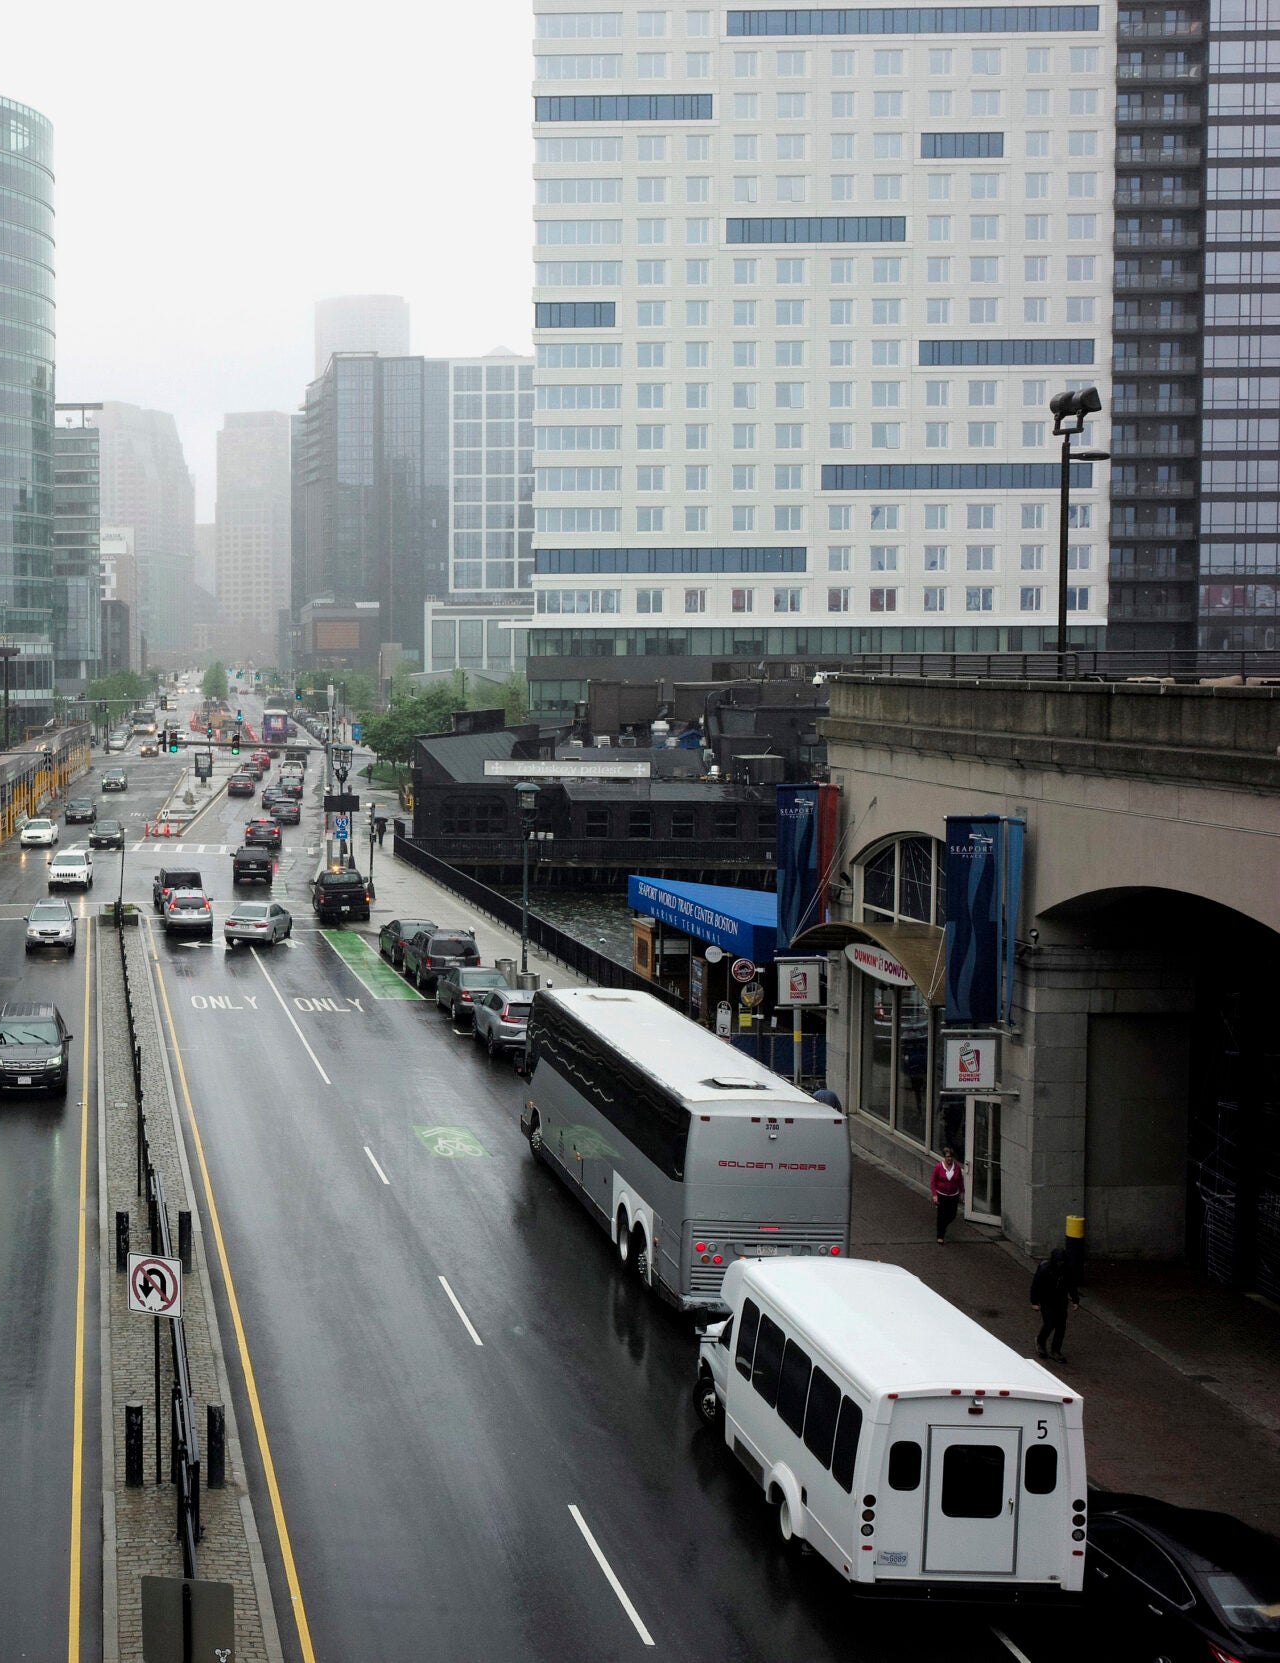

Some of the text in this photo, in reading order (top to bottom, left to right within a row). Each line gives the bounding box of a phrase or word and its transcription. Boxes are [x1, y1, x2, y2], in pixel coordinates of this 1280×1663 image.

[580, 764, 623, 776] priest
[780, 807, 814, 815] SEAPORT
[337, 819, 347, 827] 93
[950, 845, 994, 853] SEAPORT
[638, 881, 739, 936] SEAPORT WORLD TRADE CENTER BOSTON
[650, 906, 721, 945] MARINE TERMINAL
[854, 949, 909, 980] DUNKIN' DONUTS
[190, 995, 259, 1010] ONLY
[293, 997, 365, 1013] ONLY
[718, 1160, 774, 1169] GOLDEN
[1037, 1419, 1048, 1440] 5
